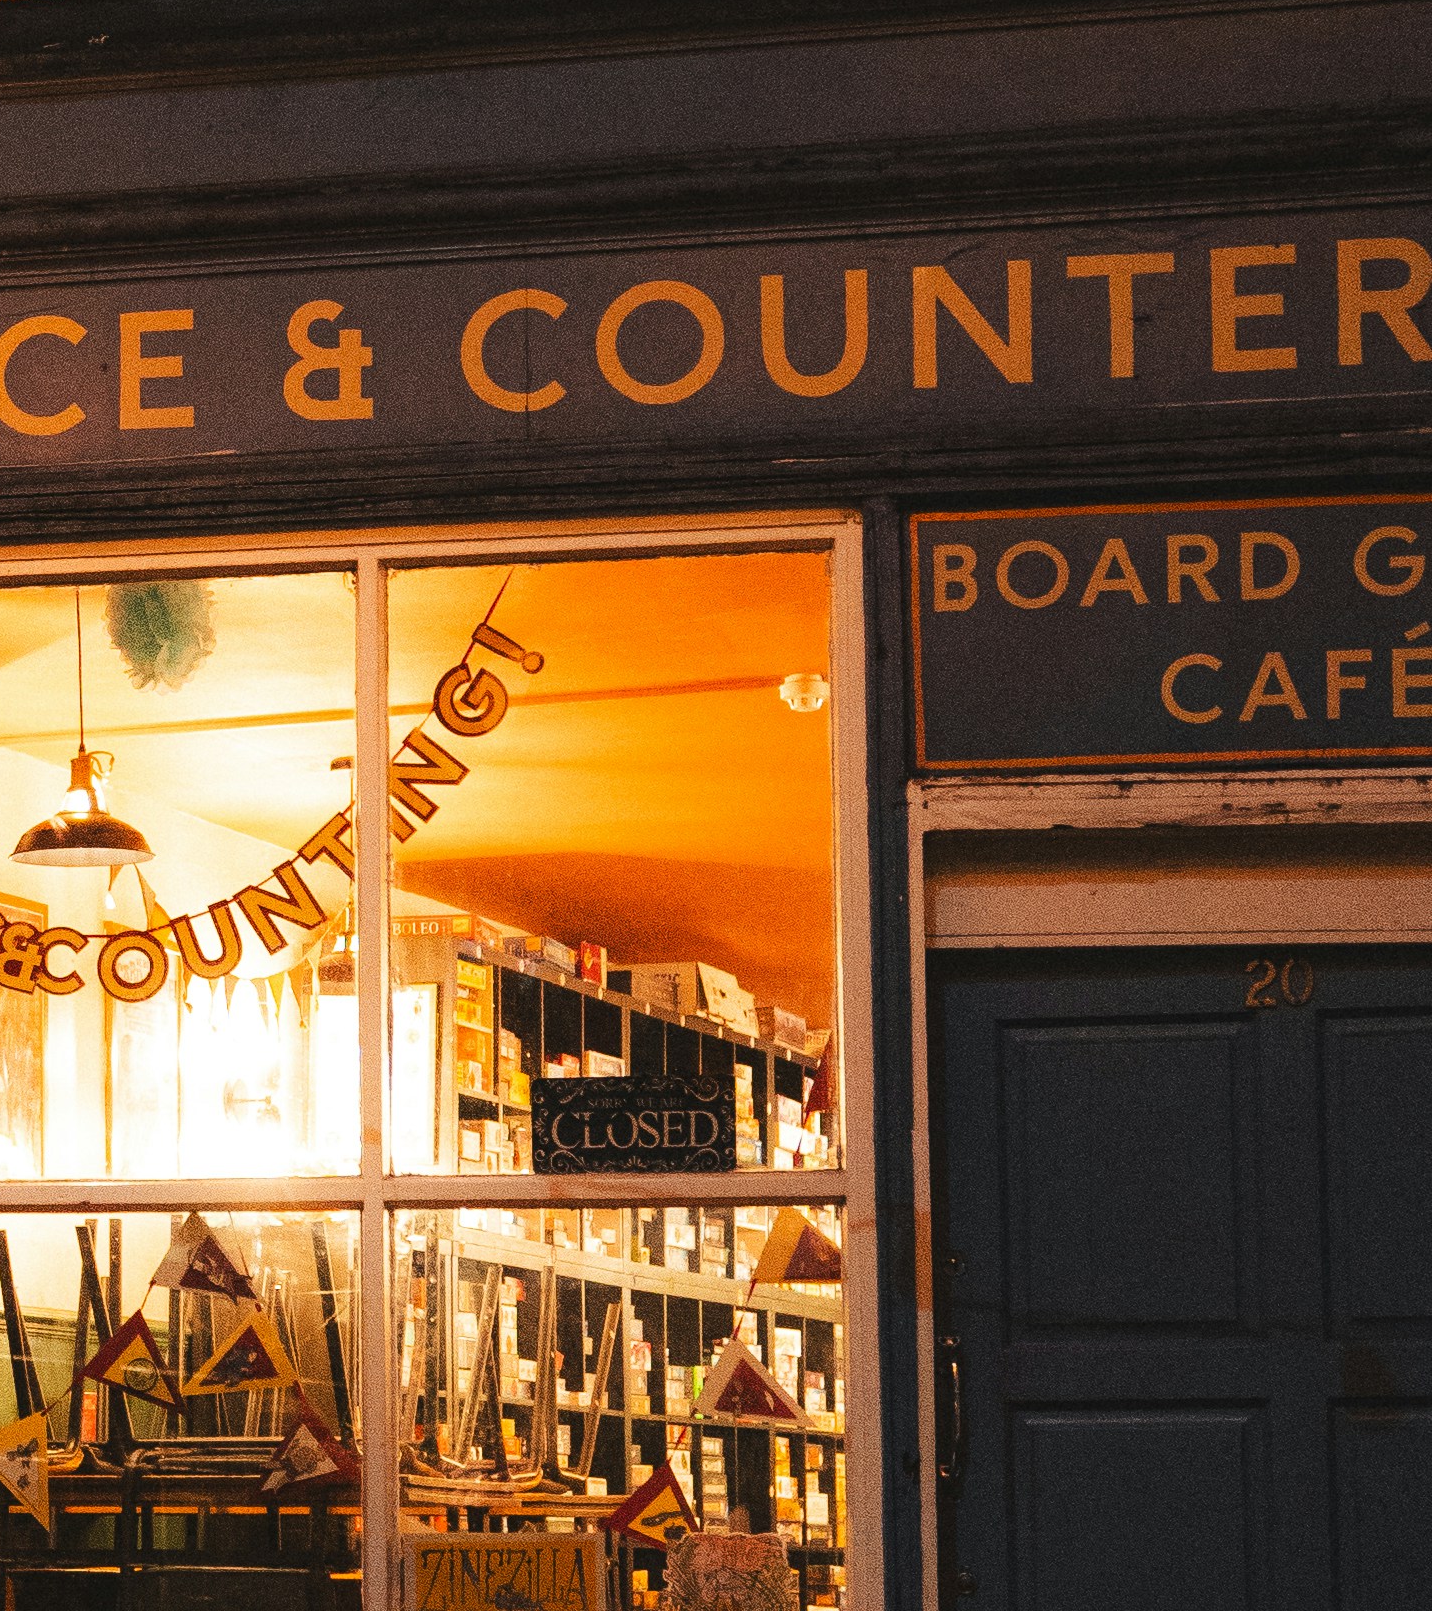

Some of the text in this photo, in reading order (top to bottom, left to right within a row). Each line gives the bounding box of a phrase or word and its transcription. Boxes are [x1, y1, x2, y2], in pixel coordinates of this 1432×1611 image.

[283, 299, 374, 421] &
[460, 238, 1432, 413] COUNTER
[932, 531, 1301, 613] BOARD
[1161, 621, 1432, 724] CAFÉ
[1244, 958, 1314, 1009] 20
[551, 1110, 719, 1149] CLOSED
